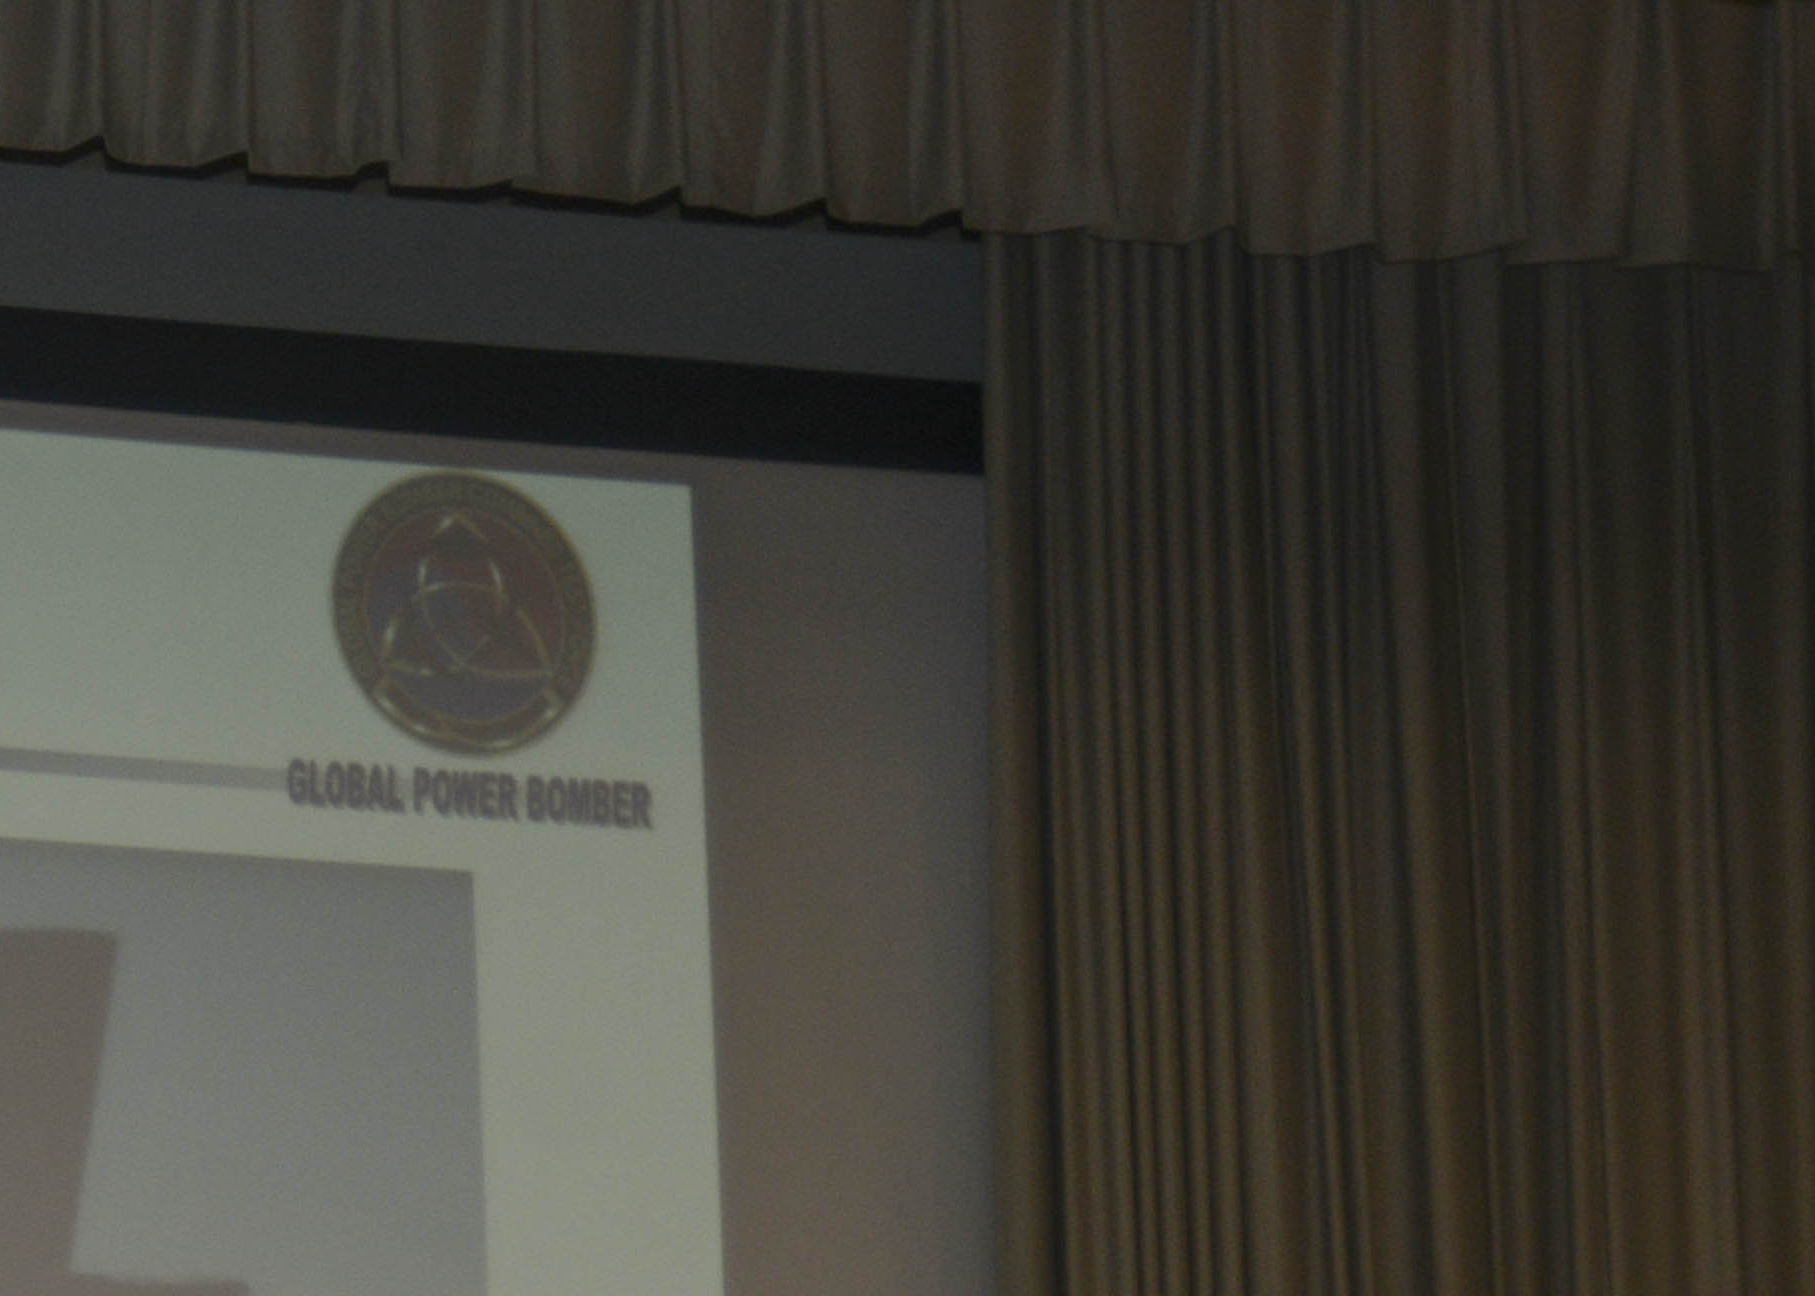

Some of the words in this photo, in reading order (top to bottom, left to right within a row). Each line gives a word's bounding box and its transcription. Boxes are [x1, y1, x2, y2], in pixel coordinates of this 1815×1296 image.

[286, 757, 406, 815] GLOBAL
[413, 766, 519, 823] POWER
[525, 774, 654, 830] BOMBER
